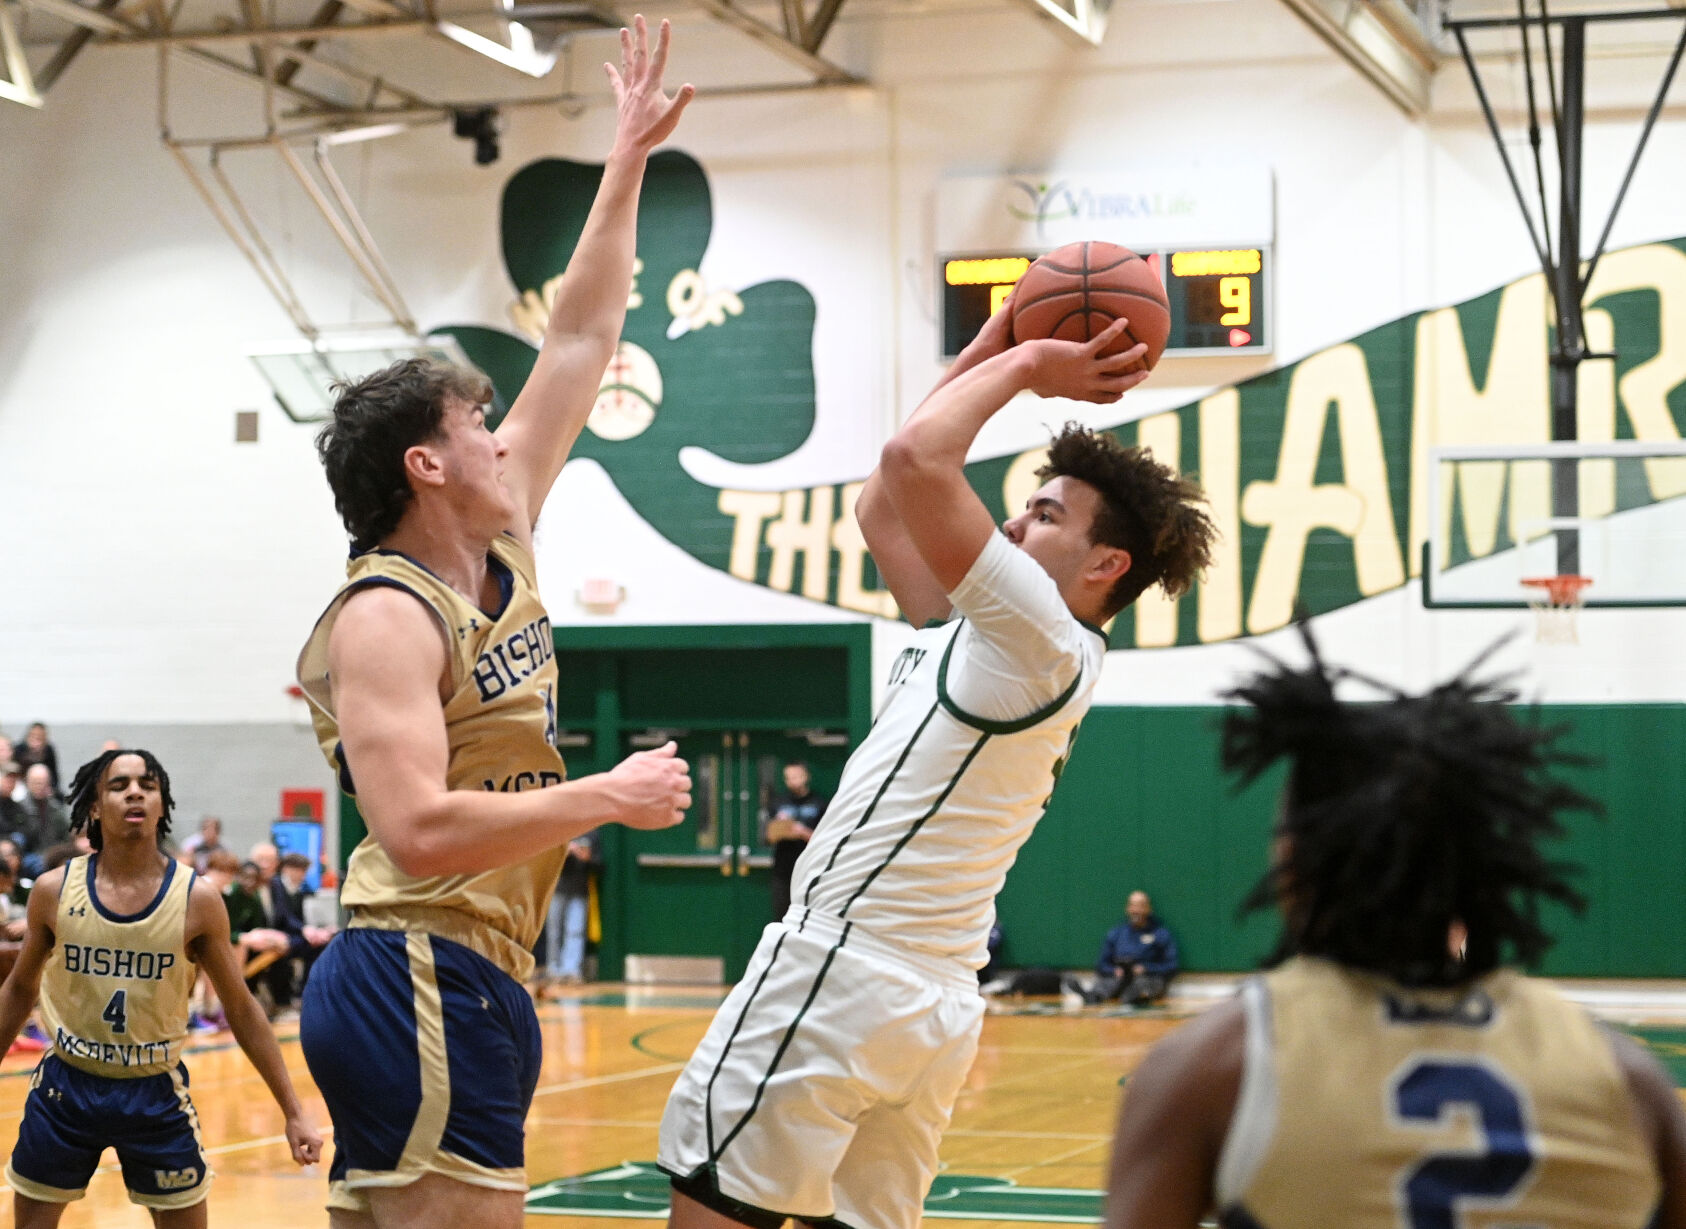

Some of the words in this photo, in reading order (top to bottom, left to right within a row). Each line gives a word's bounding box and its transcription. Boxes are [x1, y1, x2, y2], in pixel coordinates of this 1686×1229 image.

[1219, 276, 1250, 326] 9
[718, 477, 900, 620] THE
[1003, 243, 1686, 648] HAMR
[64, 943, 175, 980] BISHOP
[102, 989, 127, 1034] 4
[1392, 1058, 1537, 1229] 2
